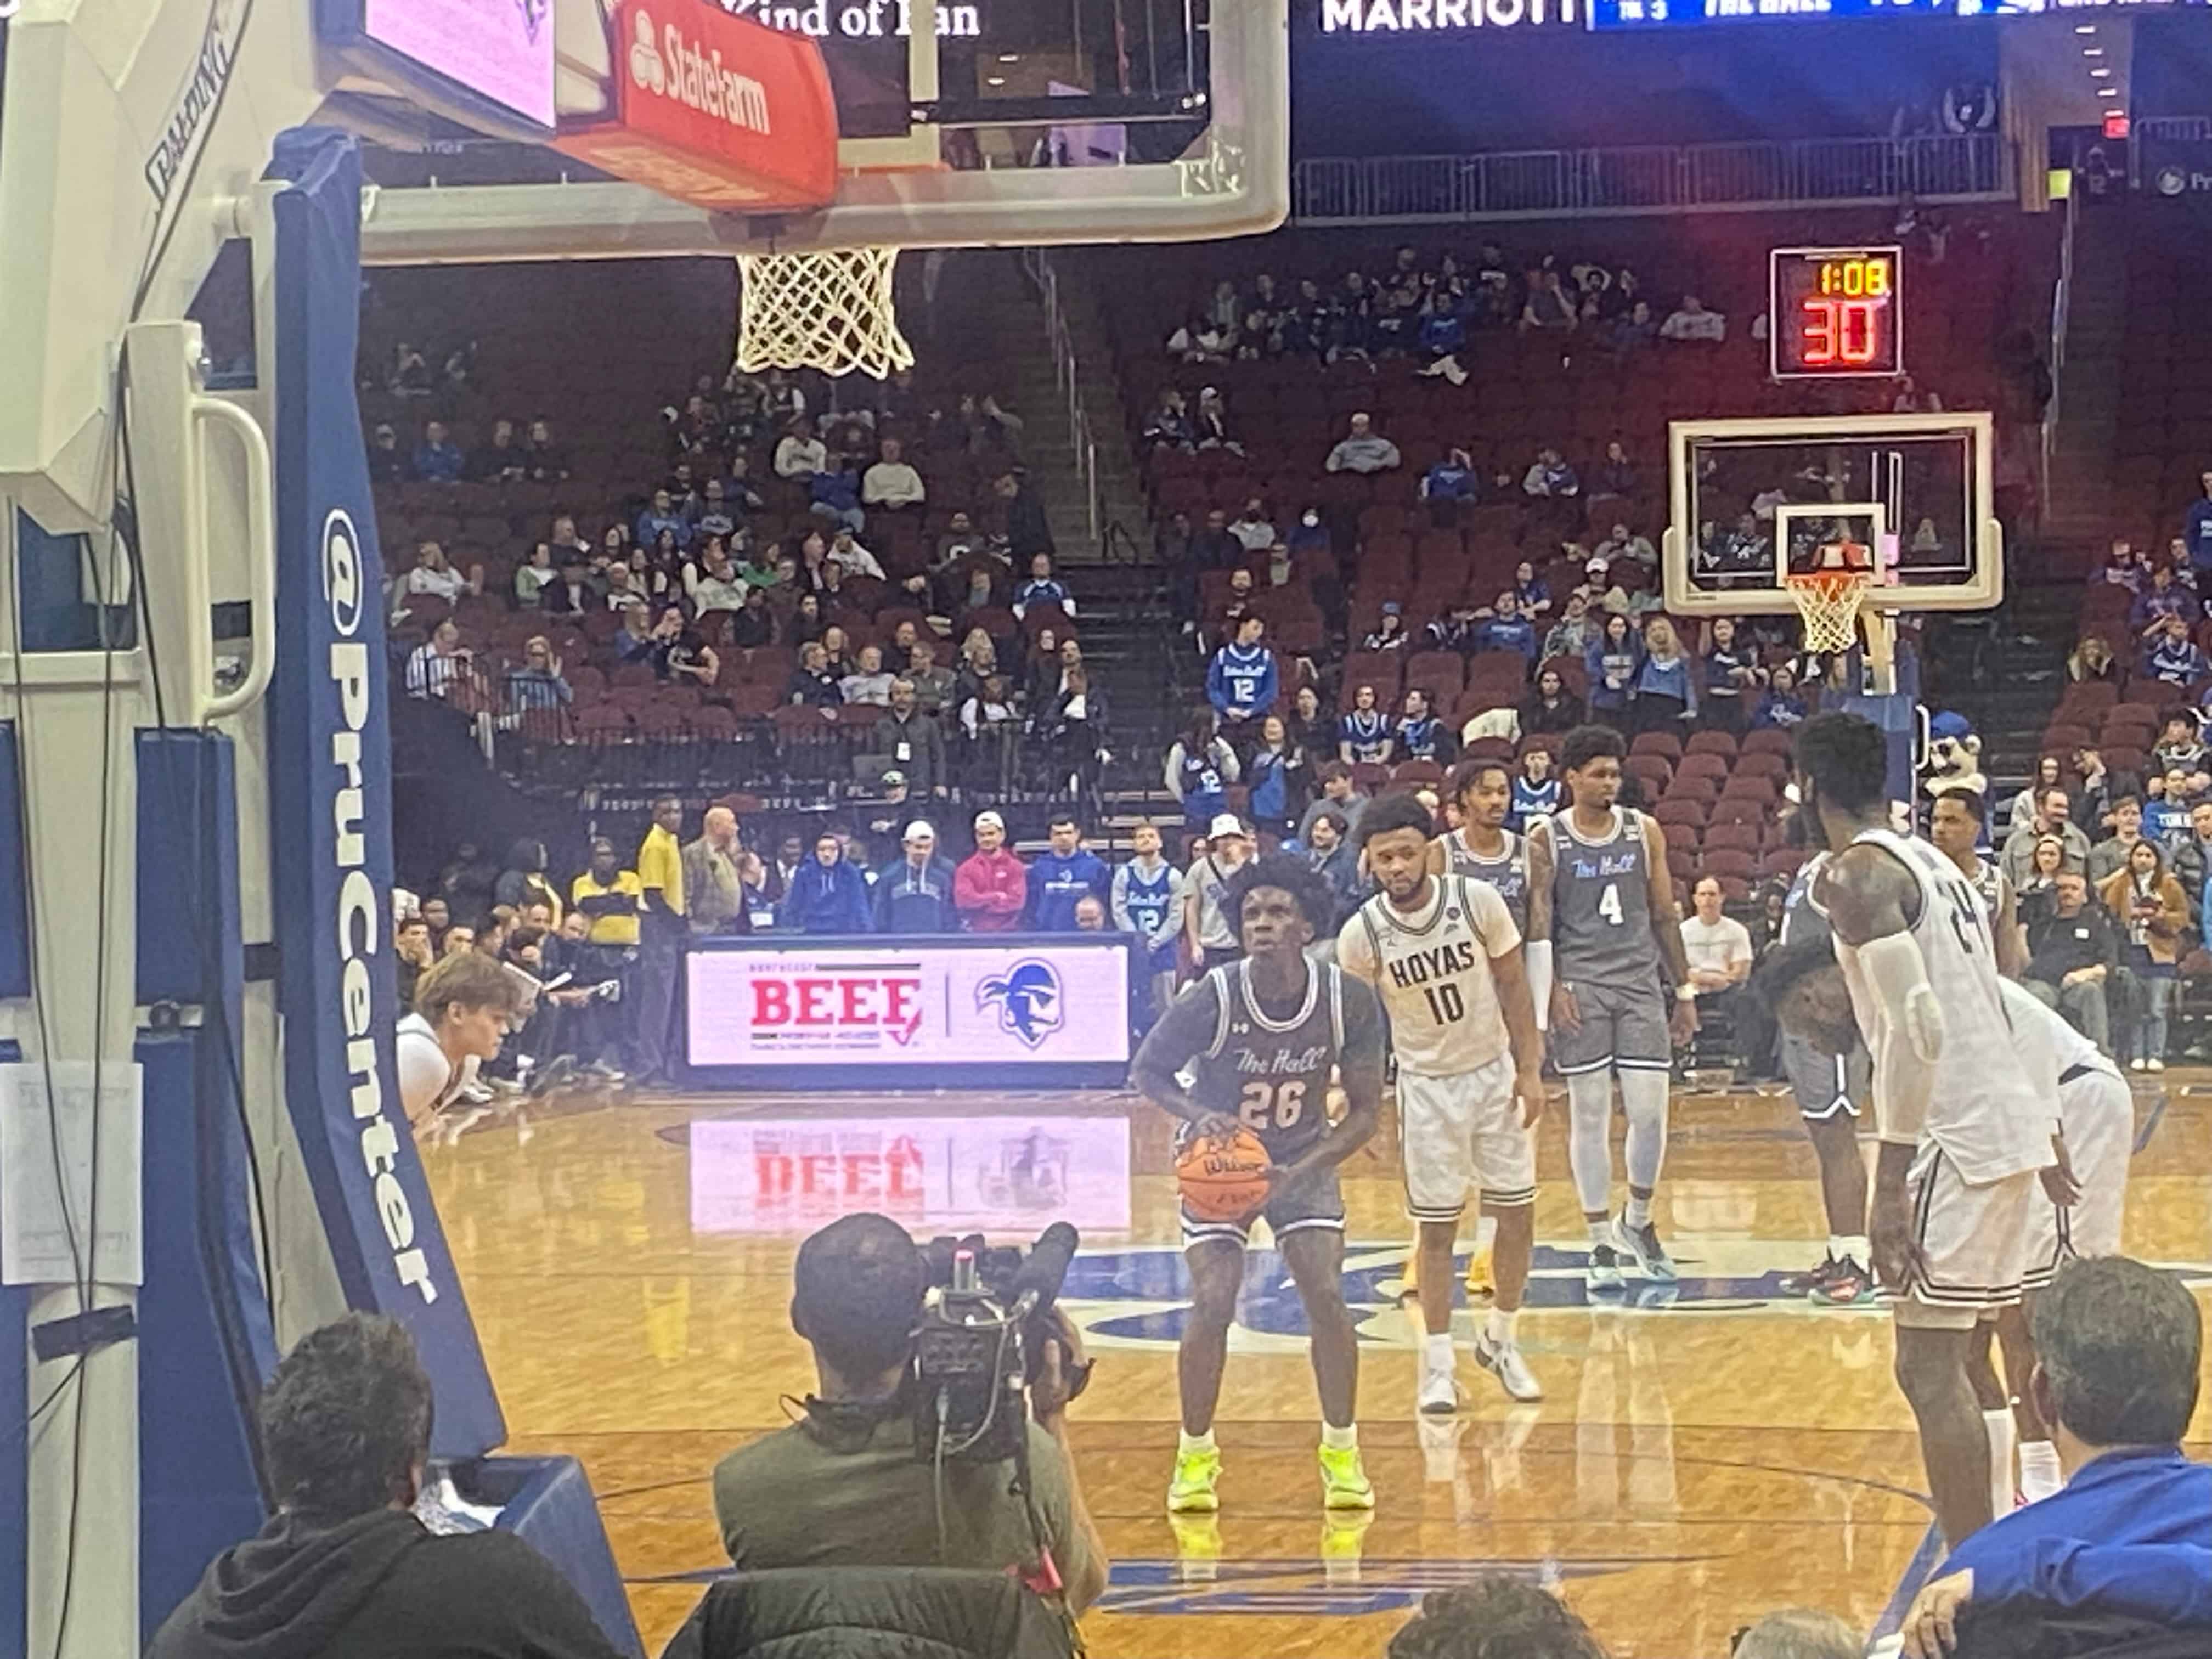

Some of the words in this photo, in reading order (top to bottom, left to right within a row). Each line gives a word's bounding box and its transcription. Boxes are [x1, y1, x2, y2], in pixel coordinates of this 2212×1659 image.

[840, 0, 885, 36] of
[895, 0, 980, 36] an
[1804, 301, 1875, 363] 30
[1233, 678, 1255, 702] 12
[1599, 882, 1624, 926] 4
[1389, 941, 1475, 988] HOYAS
[751, 978, 921, 1025] BEEF
[1424, 983, 1464, 1025] 10
[1233, 1047, 1269, 1074] The
[1271, 1045, 1328, 1073] Hall
[1239, 1081, 1306, 1129] 26
